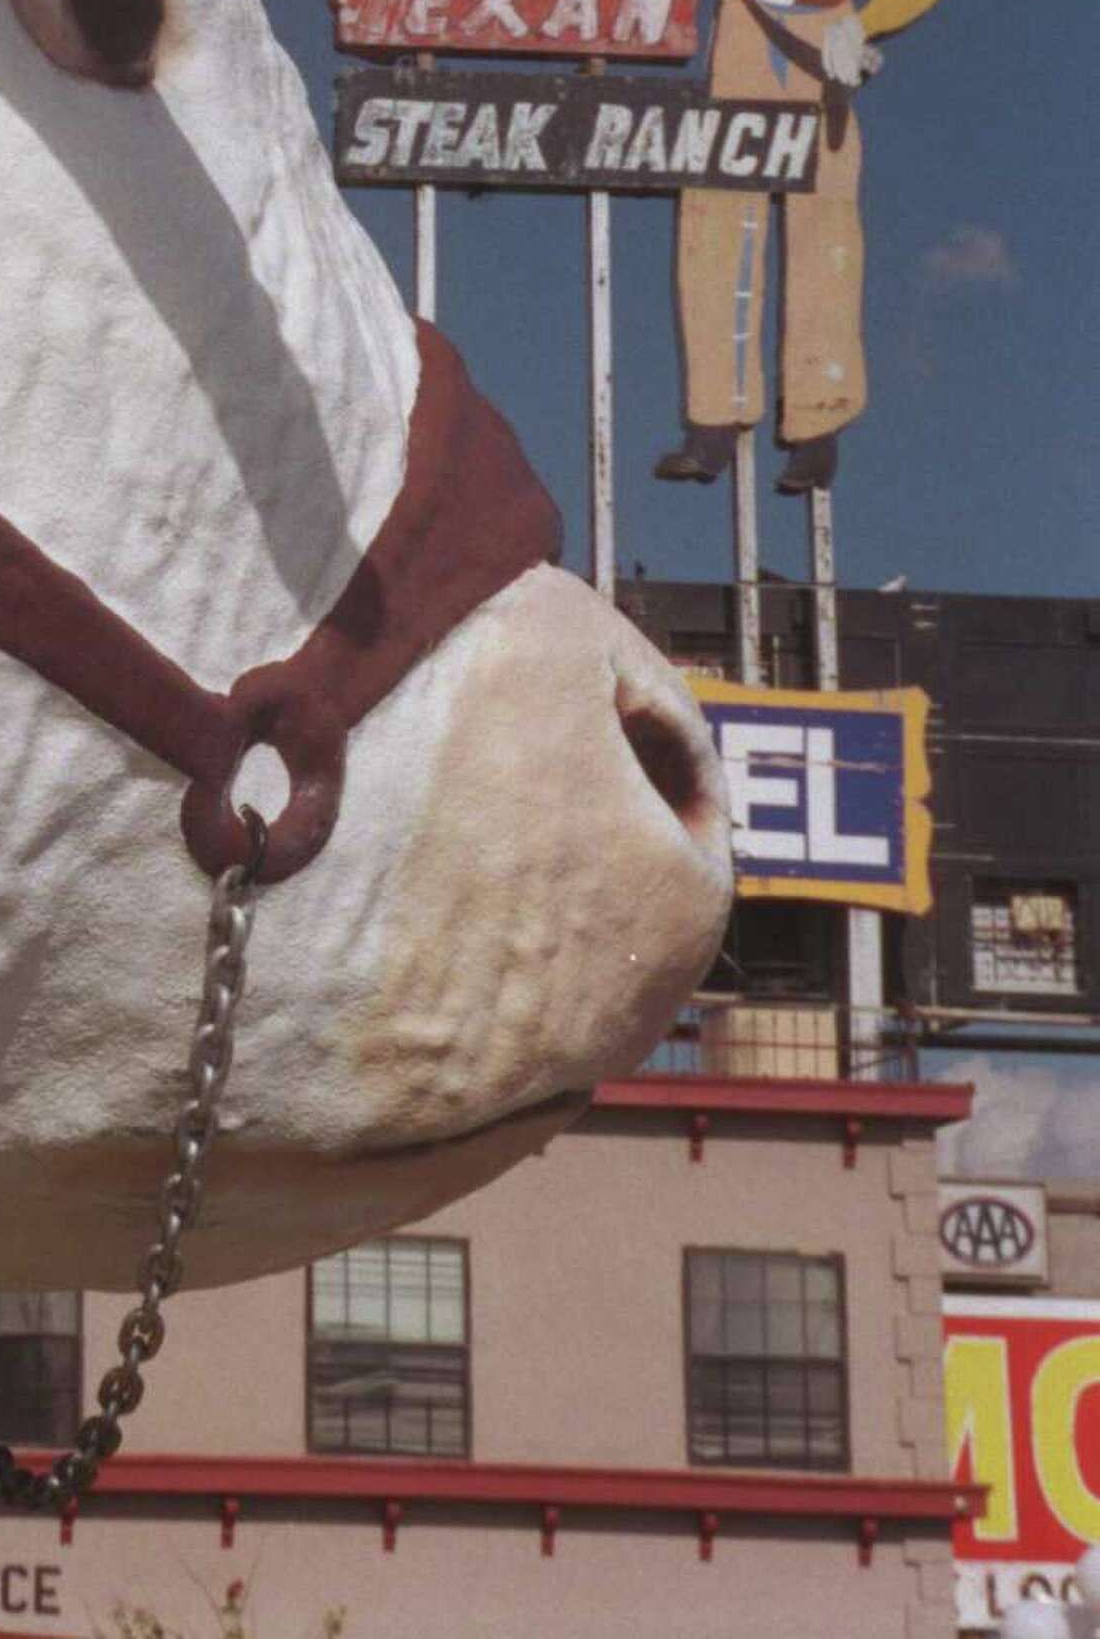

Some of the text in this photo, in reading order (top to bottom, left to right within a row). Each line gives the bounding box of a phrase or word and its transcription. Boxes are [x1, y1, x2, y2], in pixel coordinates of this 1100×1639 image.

[347, 97, 818, 181] STEAK RANCH
[707, 721, 890, 866] EL
[948, 1202, 1025, 1263] AAA
